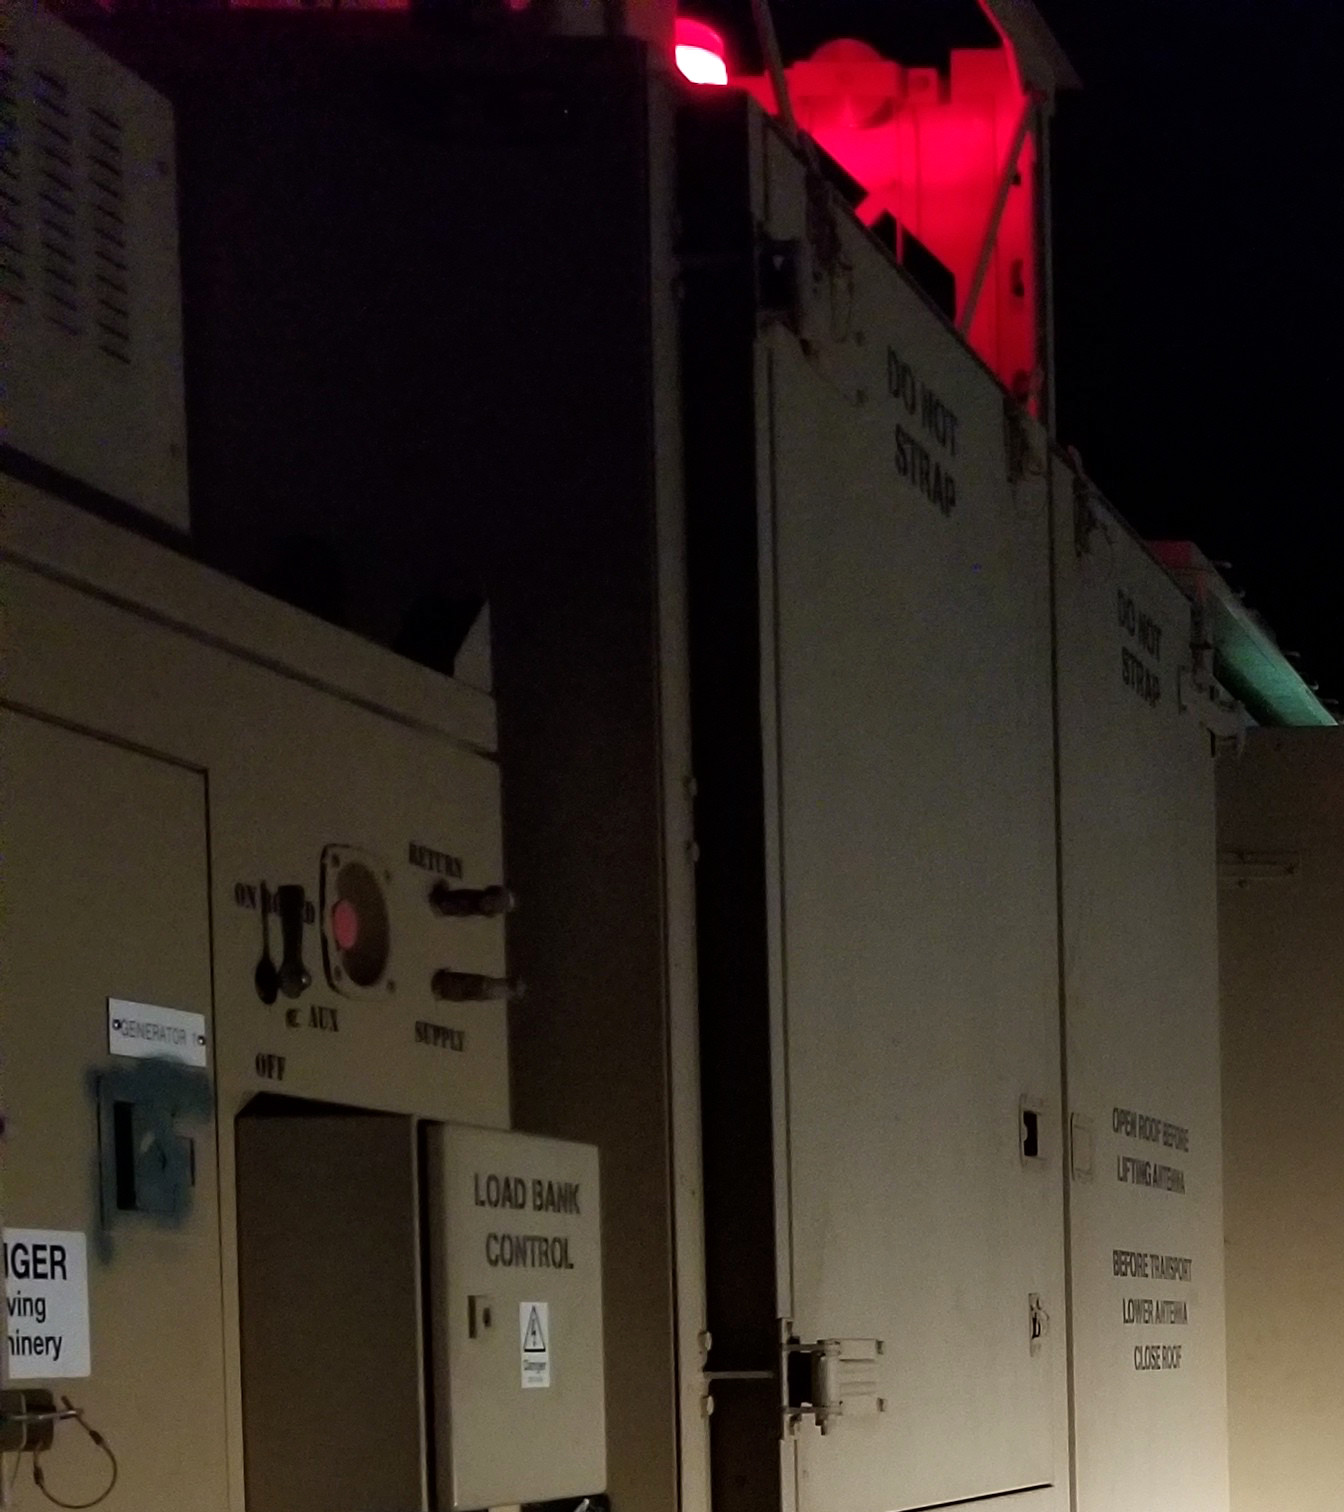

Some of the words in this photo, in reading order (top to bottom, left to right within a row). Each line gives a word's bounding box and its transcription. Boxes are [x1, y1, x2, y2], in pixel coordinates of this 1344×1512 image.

[886, 345, 916, 415] DO
[921, 382, 957, 456] NOT
[895, 424, 956, 517] STRAP
[1117, 589, 1136, 637] DO
[1137, 610, 1162, 661] NOT
[1121, 646, 1161, 708] STRAP
[408, 842, 463, 879] RETURN
[121, 1018, 187, 1046] GENERATOR
[308, 1005, 339, 1032] AUX
[415, 1020, 465, 1052] SUPPLY
[255, 1053, 286, 1080] OFF
[1112, 1107, 1137, 1138] OPEN
[1138, 1114, 1161, 1143] ROOF
[1163, 1121, 1189, 1152] BEFORE
[474, 1172, 527, 1209] LOAD
[532, 1179, 581, 1214] BANK
[1117, 1155, 1152, 1187] LIFTING
[1153, 1163, 1186, 1195] ANTENNA
[486, 1232, 574, 1269] CONTROL
[1112, 1249, 1149, 1278] BEFORE
[1150, 1253, 1192, 1282] TRANSPORT
[1122, 1298, 1154, 1325] LOWER
[1155, 1299, 1188, 1325] ANTENNA
[1134, 1345, 1161, 1370] CLOSE
[1162, 1345, 1182, 1370] ROOF
